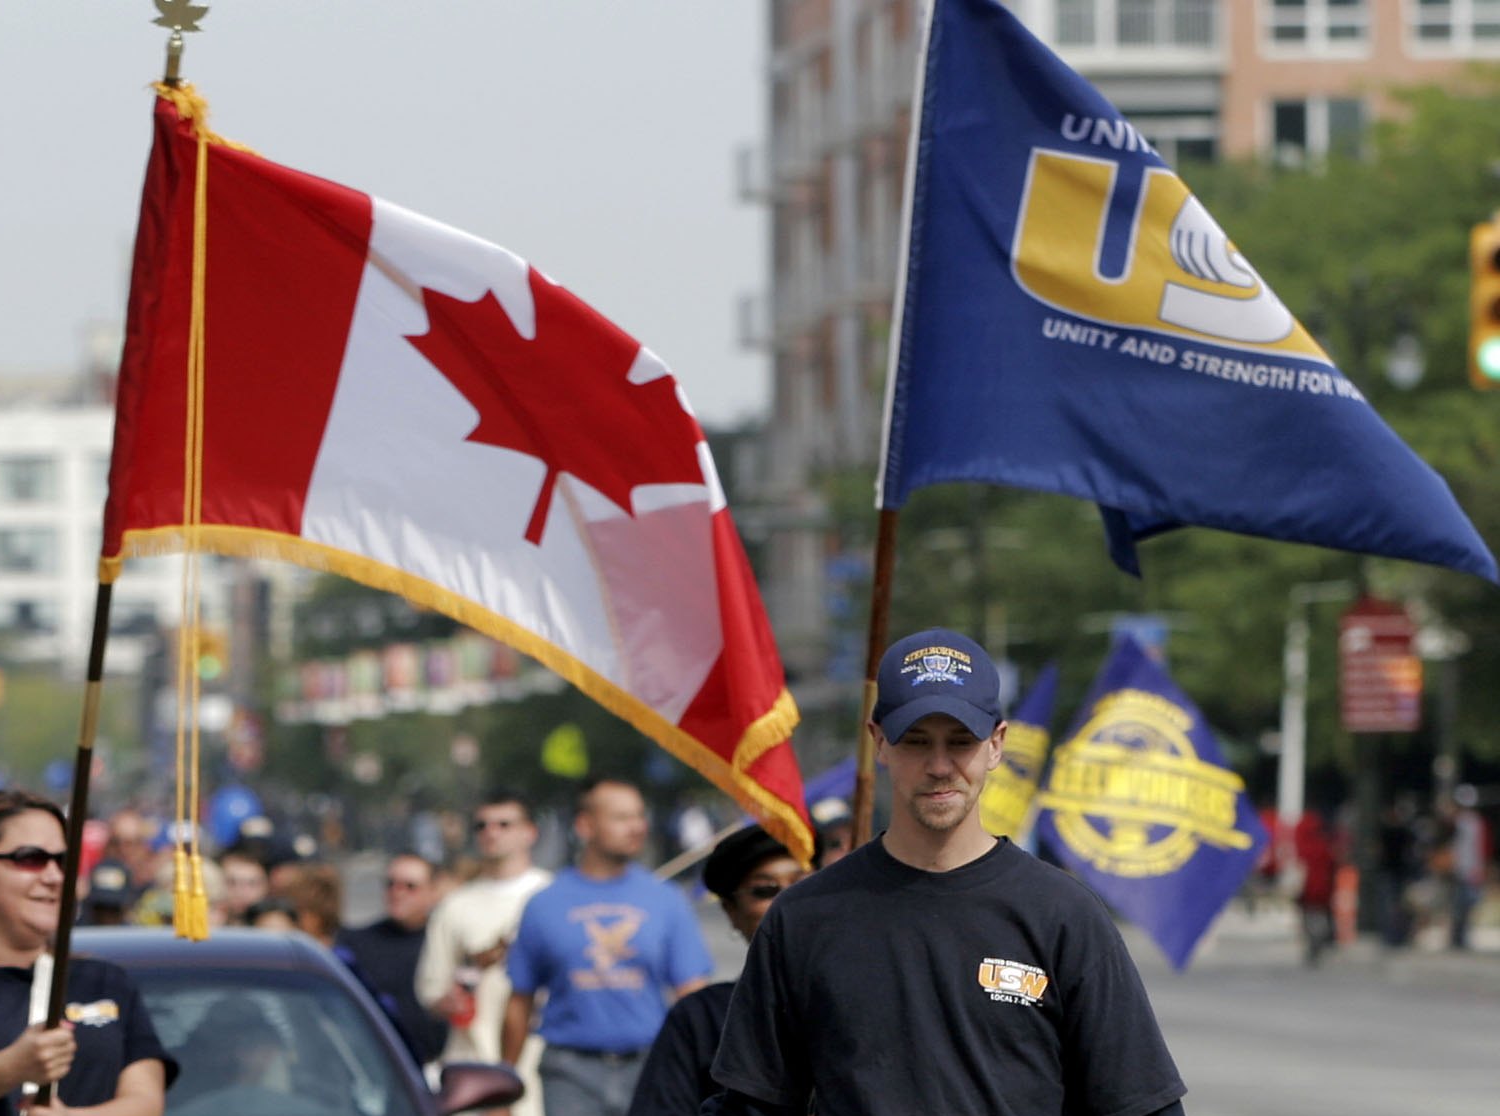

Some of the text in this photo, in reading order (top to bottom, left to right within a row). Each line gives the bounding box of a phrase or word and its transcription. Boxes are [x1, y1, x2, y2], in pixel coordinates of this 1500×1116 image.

[1061, 113, 1160, 157] UNI
[1042, 318, 1119, 350] UNITY
[1119, 336, 1177, 365] AND
[1180, 350, 1295, 391] STRENGTH
[1299, 370, 1333, 396] FOR
[978, 962, 1049, 999] USW
[990, 993, 1013, 1003] LOCAL
